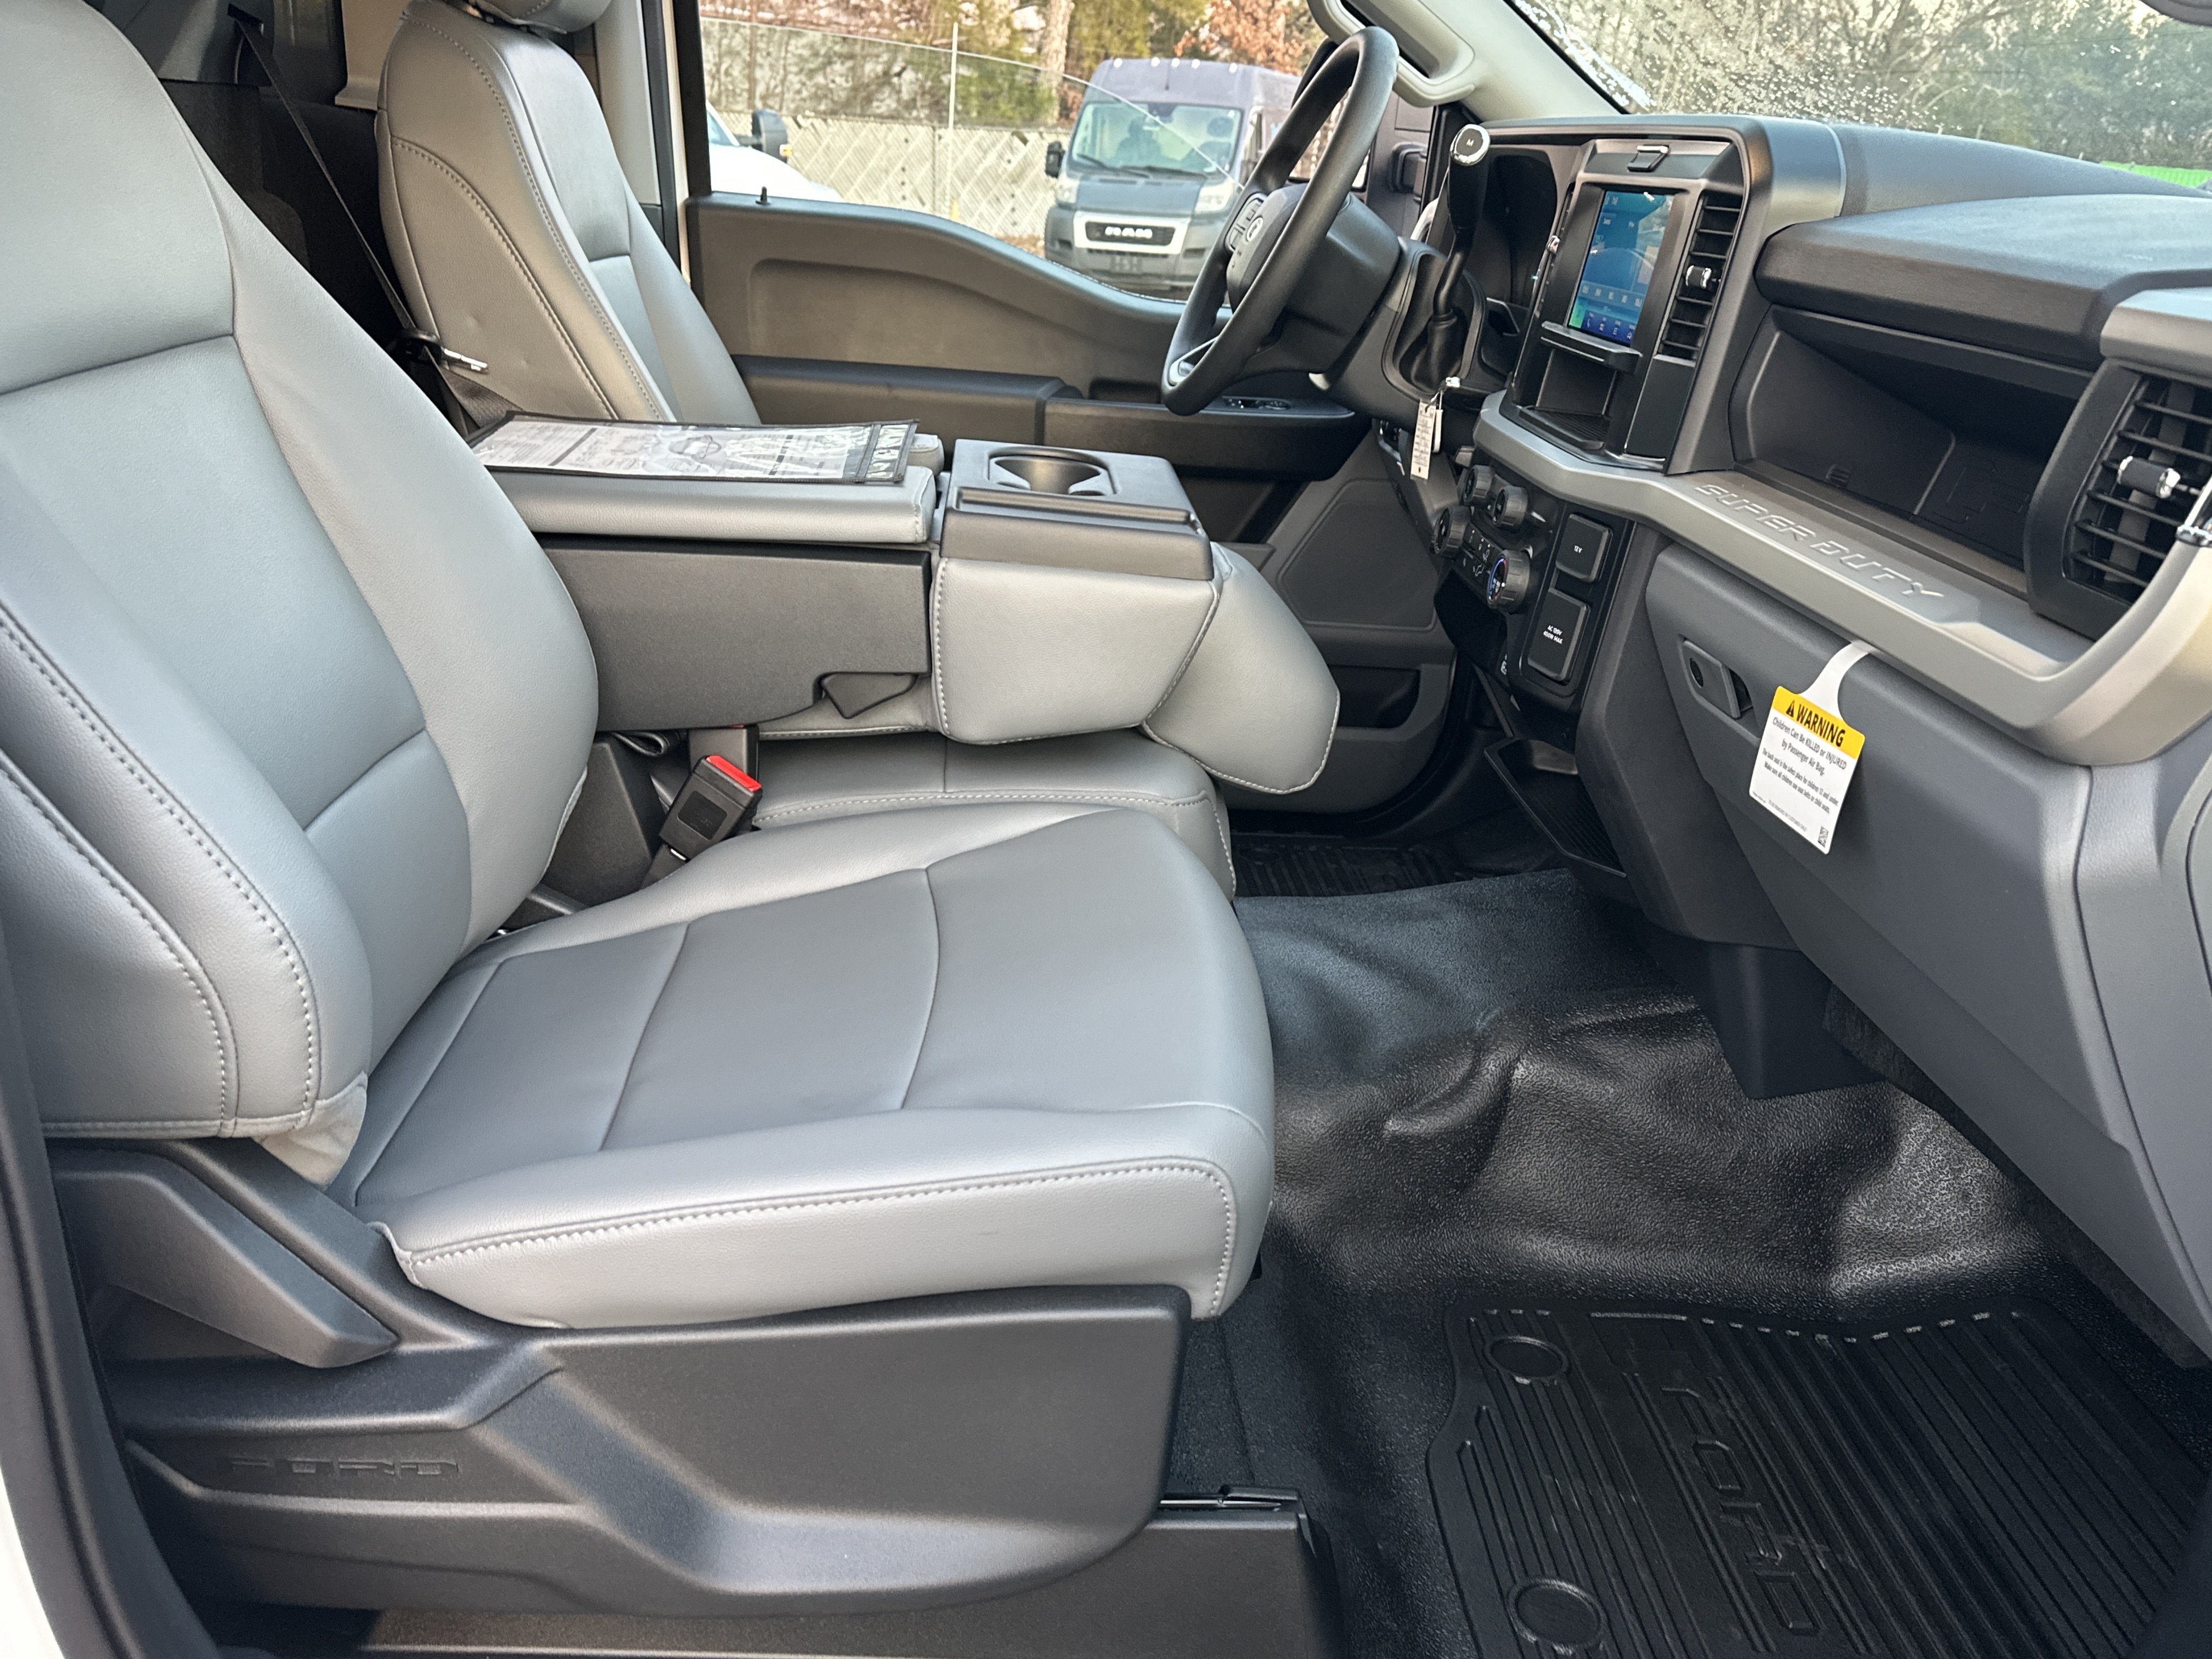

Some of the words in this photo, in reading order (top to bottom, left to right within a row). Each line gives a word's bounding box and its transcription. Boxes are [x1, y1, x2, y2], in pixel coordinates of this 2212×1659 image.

[1105, 226, 1153, 239] RAM
[1694, 484, 1816, 541] SUPER
[1809, 540, 1945, 597] DUTY
[1796, 703, 1846, 748] WARNING
[1782, 739, 1787, 750] by
[1799, 734, 1805, 743] Be
[1805, 738, 1820, 753] KILLED
[1826, 752, 1847, 770] INJURED
[230, 1457, 460, 1477] FORD
